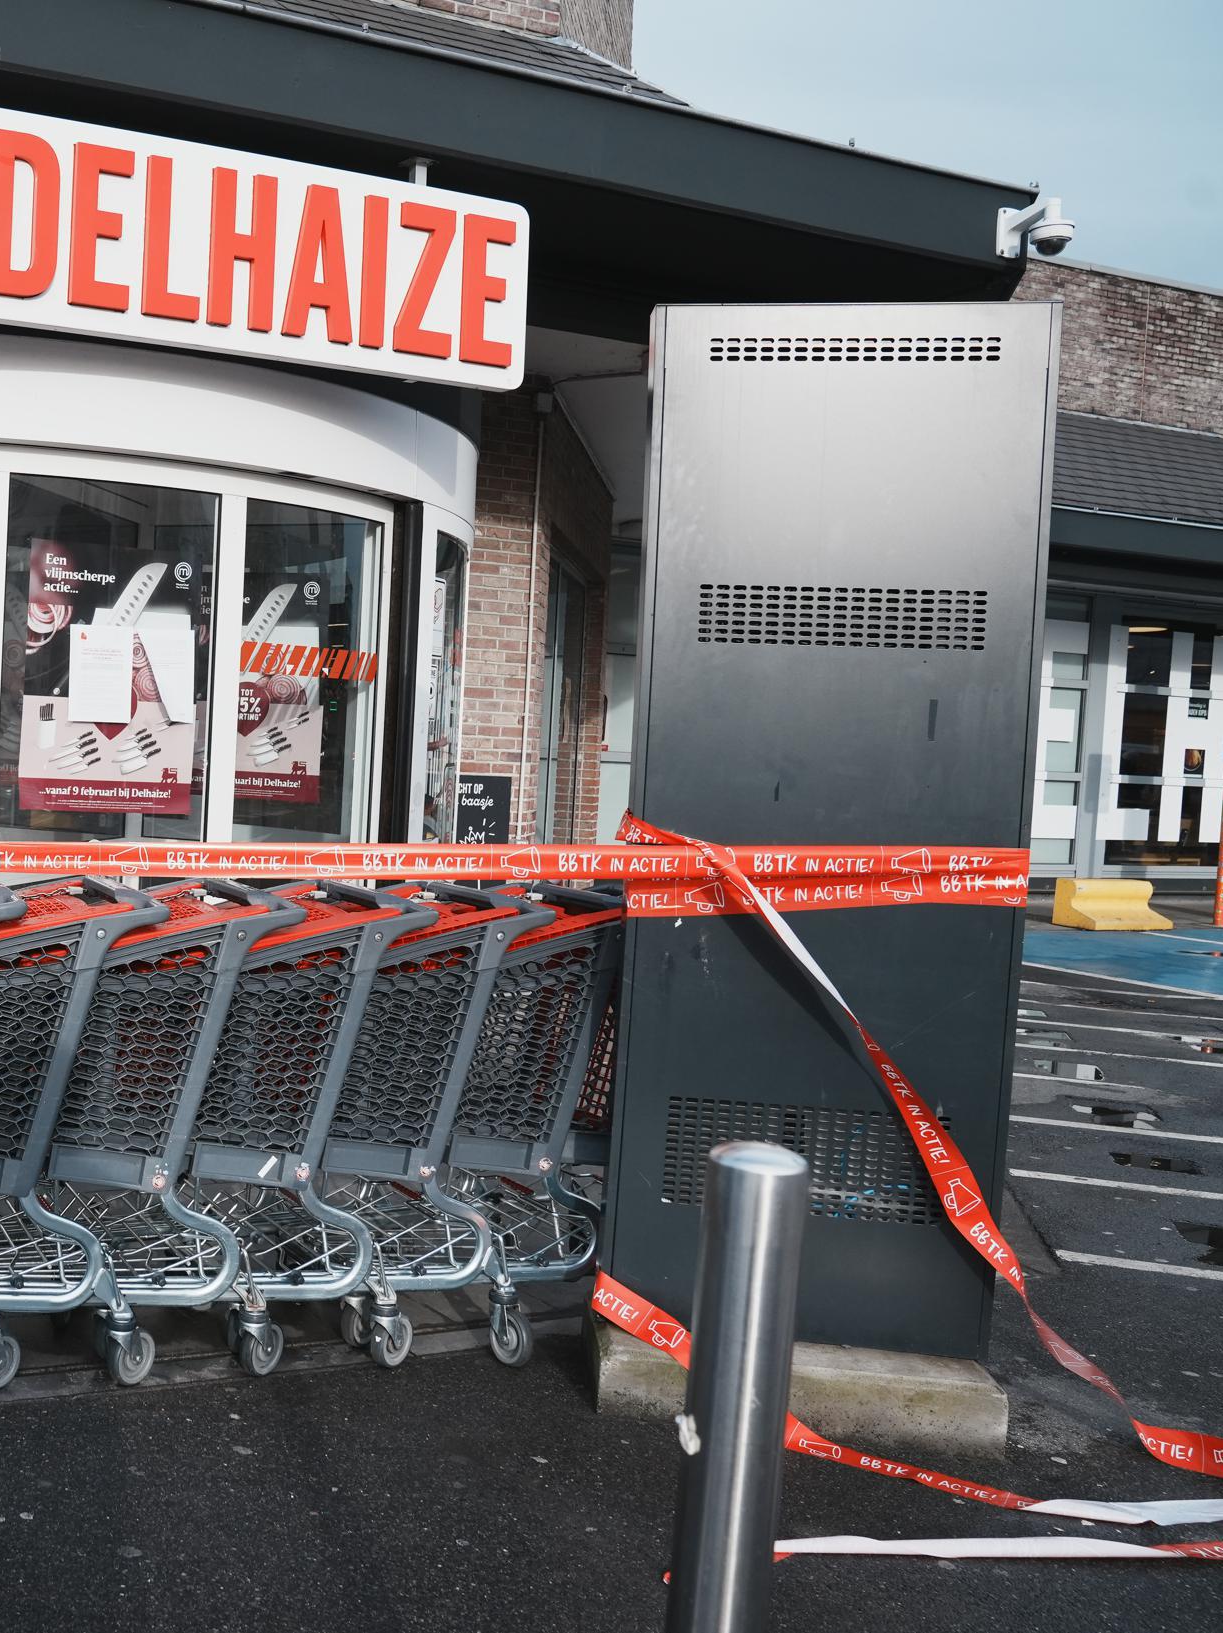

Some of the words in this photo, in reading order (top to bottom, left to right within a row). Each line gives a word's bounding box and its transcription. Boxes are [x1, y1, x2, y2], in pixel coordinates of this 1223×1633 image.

[45, 553, 67, 566] Een
[44, 567, 116, 586] vlijmscherpe
[43, 581, 79, 594] actie...
[240, 688, 254, 697] TOT
[239, 697, 261, 713] 5%
[238, 713, 261, 721] RTING
[72, 786, 79, 796] 9
[80, 786, 117, 797] februari
[118, 787, 130, 799] bij
[131, 788, 172, 799] Delhaize!
[252, 778, 263, 787] bij
[264, 778, 301, 788] Delhaize!
[457, 783, 472, 794] CHT
[473, 783, 484, 794] OP
[461, 794, 494, 811] baasje
[23, 855, 38, 868] IN
[43, 855, 92, 870] ACTIE!
[166, 851, 210, 870] BBTK
[218, 856, 232, 870] IN
[237, 855, 288, 871] ACTIE!
[362, 852, 407, 872] BBTK
[414, 856, 428, 871] IN
[433, 856, 484, 872] ACTIE!
[558, 852, 602, 873] BBTK
[609, 857, 624, 872] IN
[629, 857, 680, 873] ACTIE!
[753, 852, 798, 873] BBTK
[805, 858, 820, 873] IN
[824, 857, 874, 874] ACTIE!
[940, 873, 986, 893] BBTK
[994, 875, 1010, 891] IN
[759, 886, 786, 904] TK
[794, 889, 808, 903] IN
[813, 884, 864, 902] ACTIE!
[880, 1063, 914, 1099] BBTK
[906, 1104, 924, 1116] IN
[914, 1121, 951, 1164] ACTIE!
[969, 1221, 1009, 1264] BBTK
[1009, 1266, 1021, 1282] IN
[593, 1288, 640, 1323] ACTIE!
[1138, 1432, 1194, 1462] ACTIE!
[860, 1456, 909, 1476] BBTK
[917, 1472, 933, 1483] IN
[938, 1480, 997, 1500] ACTIE!
